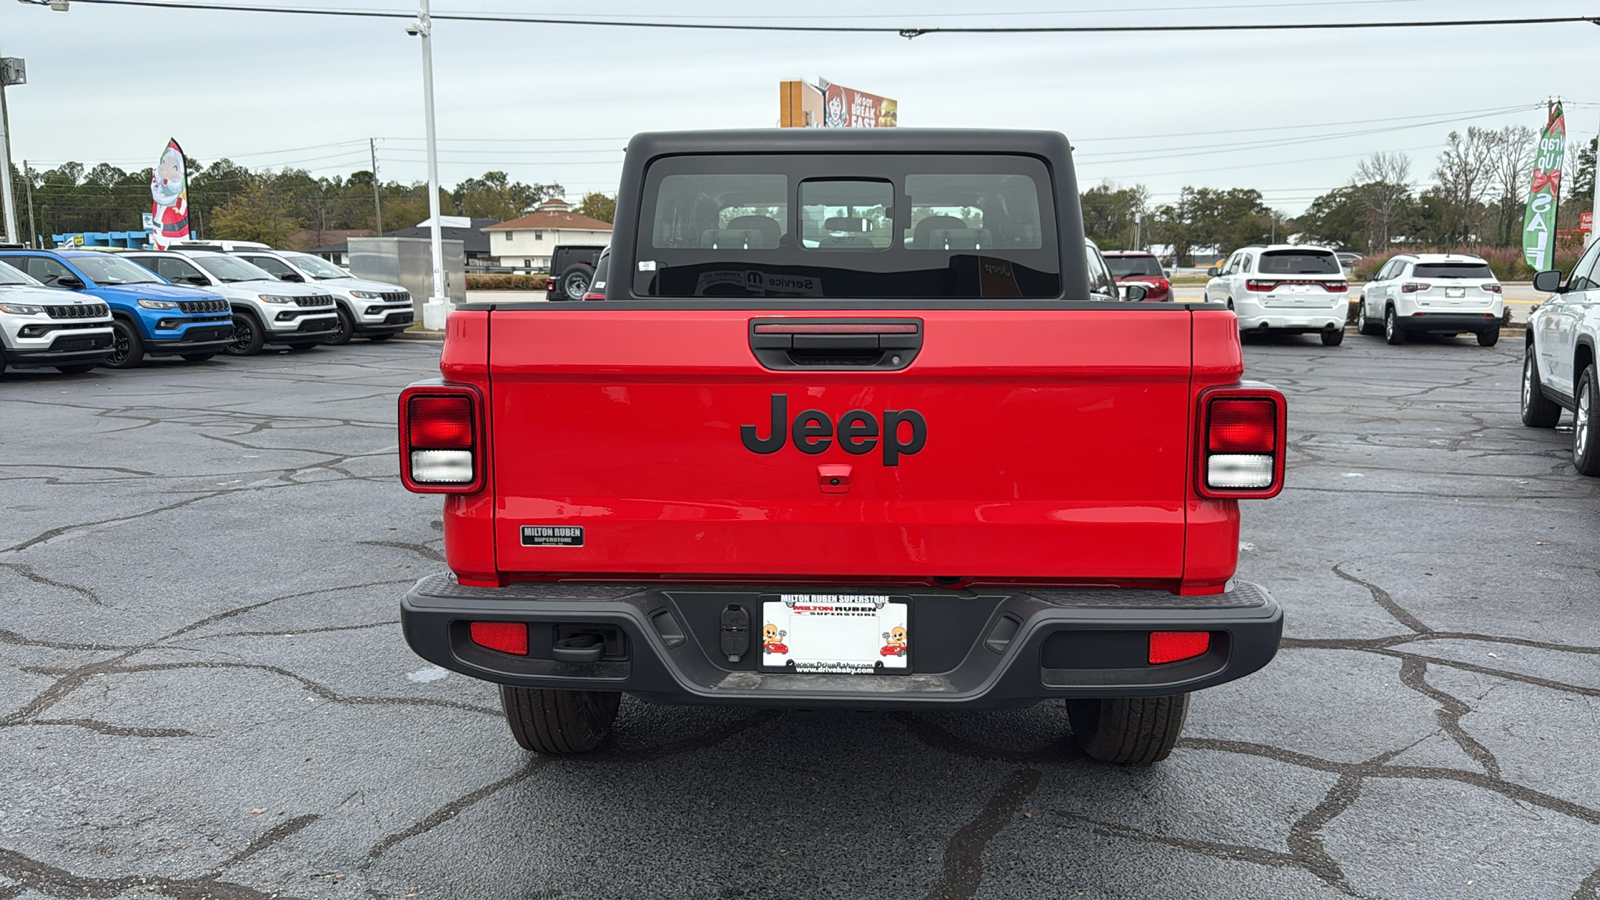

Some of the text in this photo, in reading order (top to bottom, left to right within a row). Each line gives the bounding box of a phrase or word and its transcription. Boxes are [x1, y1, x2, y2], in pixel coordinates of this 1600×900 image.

[740, 393, 928, 467] Jeep
[524, 527, 581, 537] MILTON RUBEN
[781, 594, 890, 603] MILTON RUBEN SUPERSTORE
[796, 667, 874, 675] www.drivebaby.com
